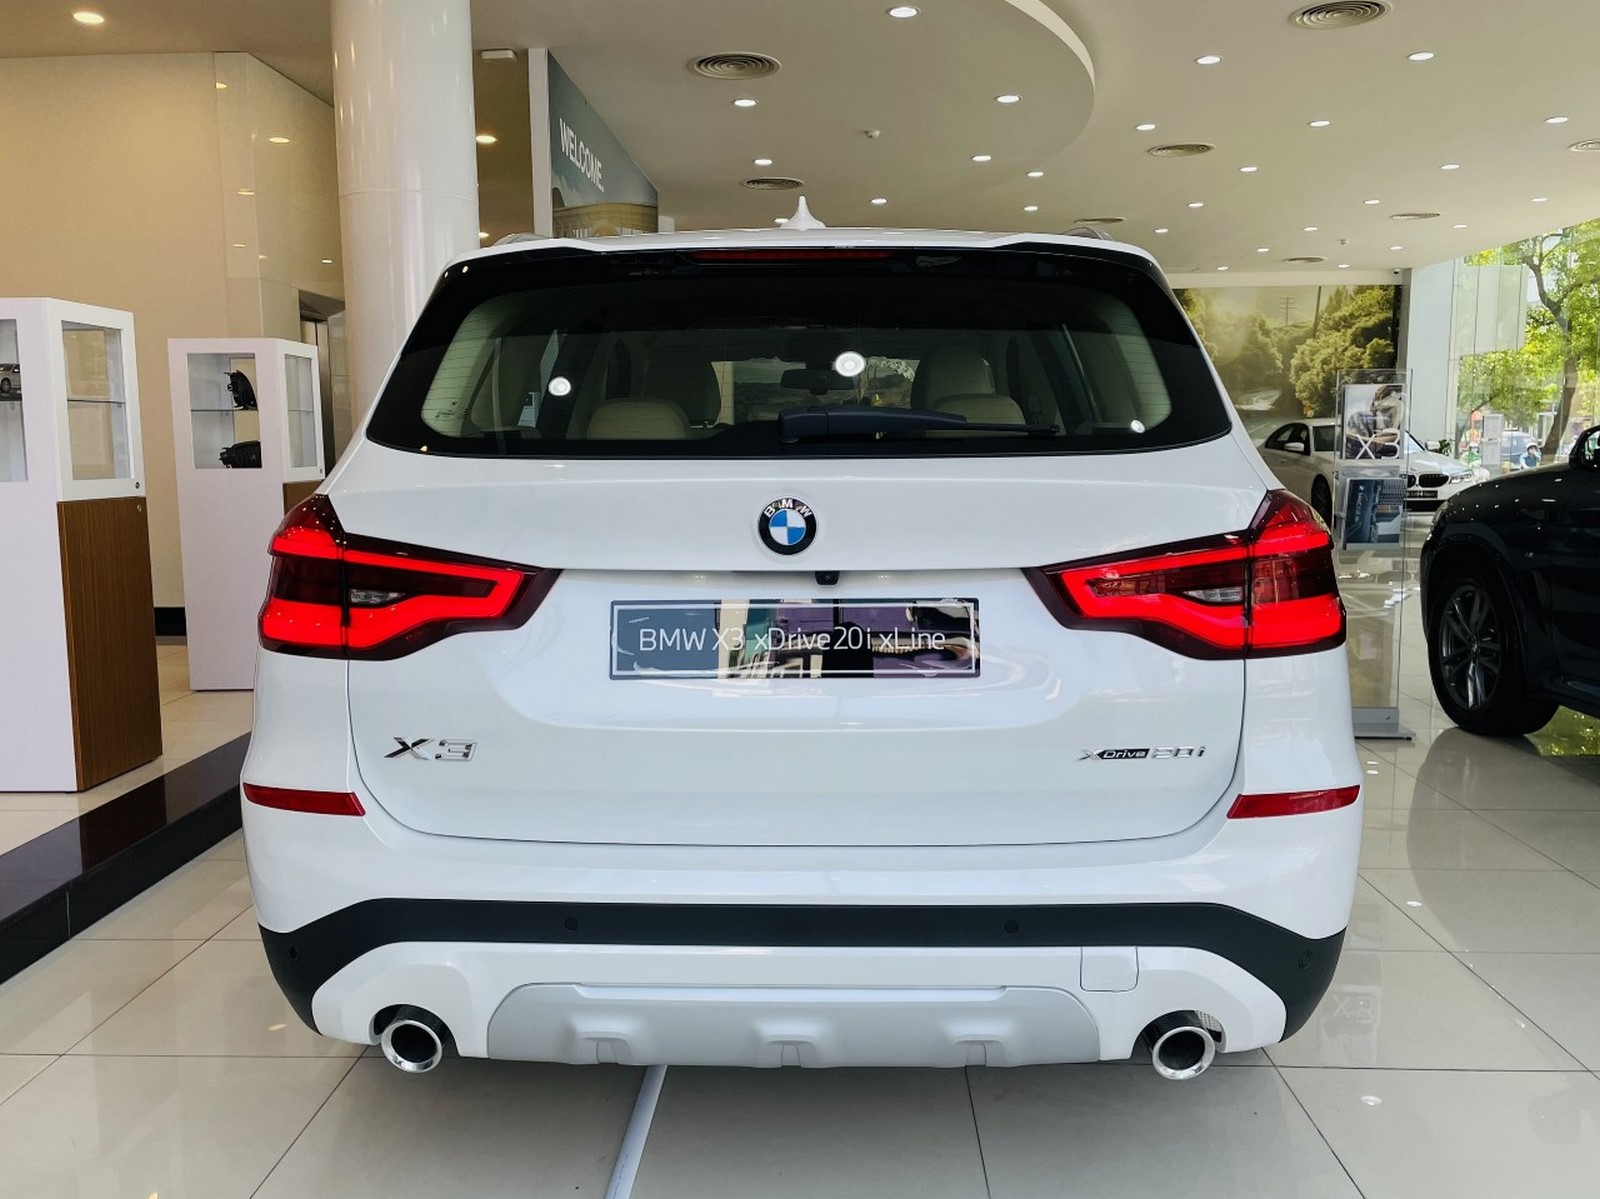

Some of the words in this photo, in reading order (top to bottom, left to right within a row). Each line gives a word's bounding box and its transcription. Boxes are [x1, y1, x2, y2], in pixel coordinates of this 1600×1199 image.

[1354, 427, 1401, 460] X3
[763, 498, 814, 518] BMW
[639, 628, 707, 651] BMW
[712, 627, 745, 651] X3
[879, 627, 946, 650] xLine
[383, 736, 478, 762] X3
